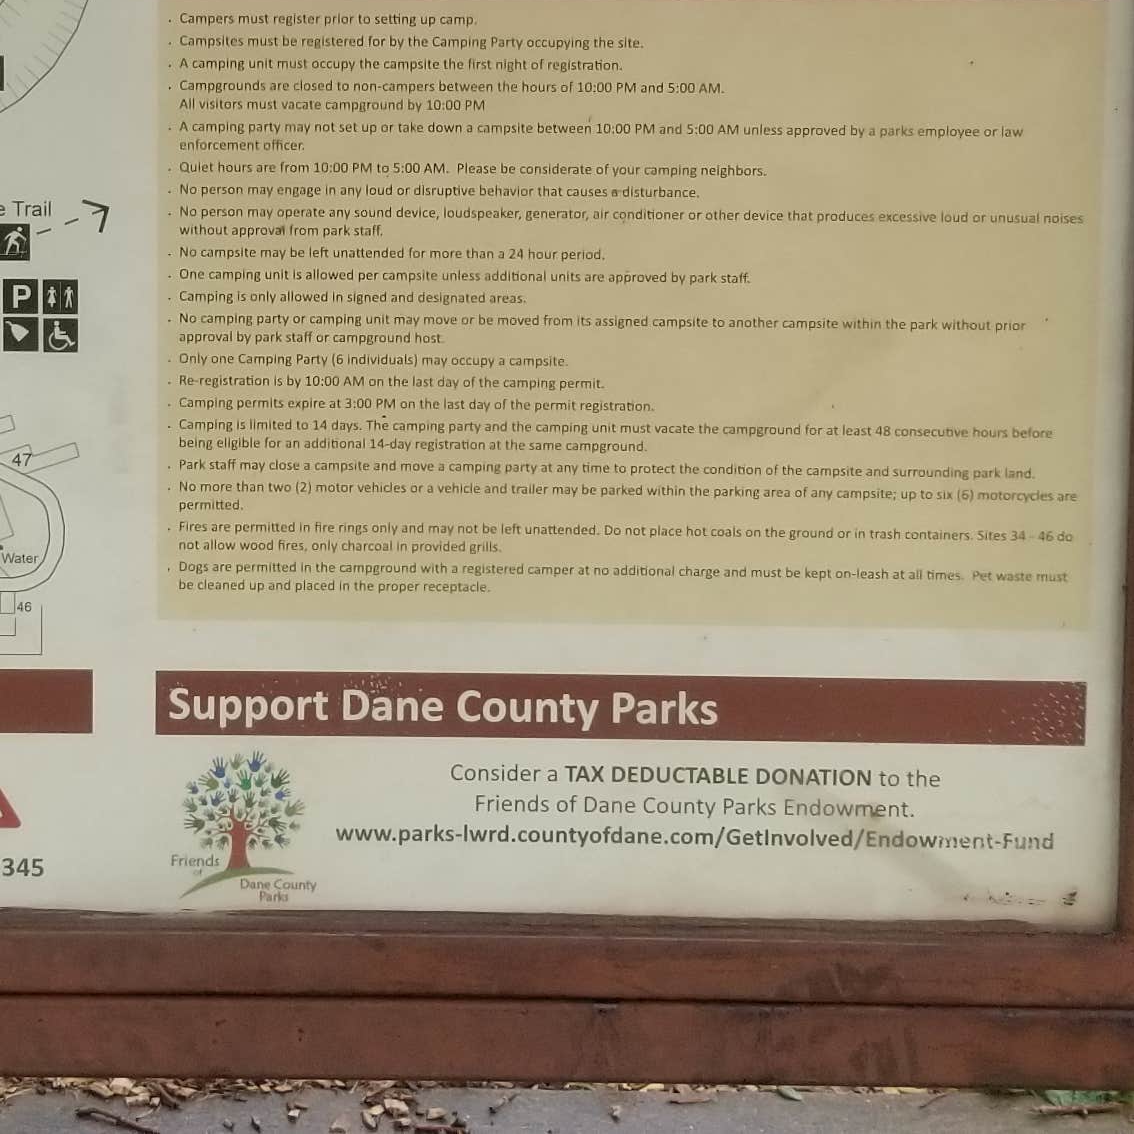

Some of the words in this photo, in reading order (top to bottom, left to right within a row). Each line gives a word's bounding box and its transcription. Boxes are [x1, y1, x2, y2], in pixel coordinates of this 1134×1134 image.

[180, 13, 235, 27] Campers
[239, 14, 268, 25] must
[273, 13, 320, 27] register
[325, 14, 354, 27] prior
[359, 14, 370, 25] to
[375, 13, 416, 28] setting
[421, 16, 436, 28] up
[12, 200, 52, 216] Trail
[12, 453, 32, 466] 47
[2, 553, 39, 564] Water
[179, 579, 194, 590] be
[197, 580, 245, 591] cleaned
[249, 582, 264, 593] up
[268, 580, 291, 591] and
[295, 580, 335, 593] placed
[339, 581, 350, 591] in
[354, 581, 374, 592] the
[379, 584, 420, 595] proper
[424, 582, 491, 595] receptacle.
[17, 602, 32, 612] 46
[169, 688, 328, 730] Support
[342, 689, 444, 723] Dane
[457, 690, 599, 732] County
[613, 691, 717, 725] Parks
[450, 764, 541, 783] Consider
[551, 769, 558, 783] a
[565, 765, 604, 783] TAX
[611, 766, 749, 785] DEDUCTABLE
[756, 767, 871, 787] DONATION
[880, 771, 899, 788] to
[907, 769, 941, 788] the
[475, 795, 549, 813] Friends
[556, 794, 576, 813] of
[584, 796, 636, 814] Dane
[643, 797, 716, 819] County
[723, 798, 777, 816] Parks
[784, 799, 915, 819] Endowment.
[336, 822, 1055, 853] www.parks-lwrd.countyofdane.com/GetInvolved/Endowment-Fund
[171, 854, 220, 867] Friends
[240, 878, 270, 890] Dane
[274, 879, 317, 892] County
[259, 891, 289, 903] Parks
